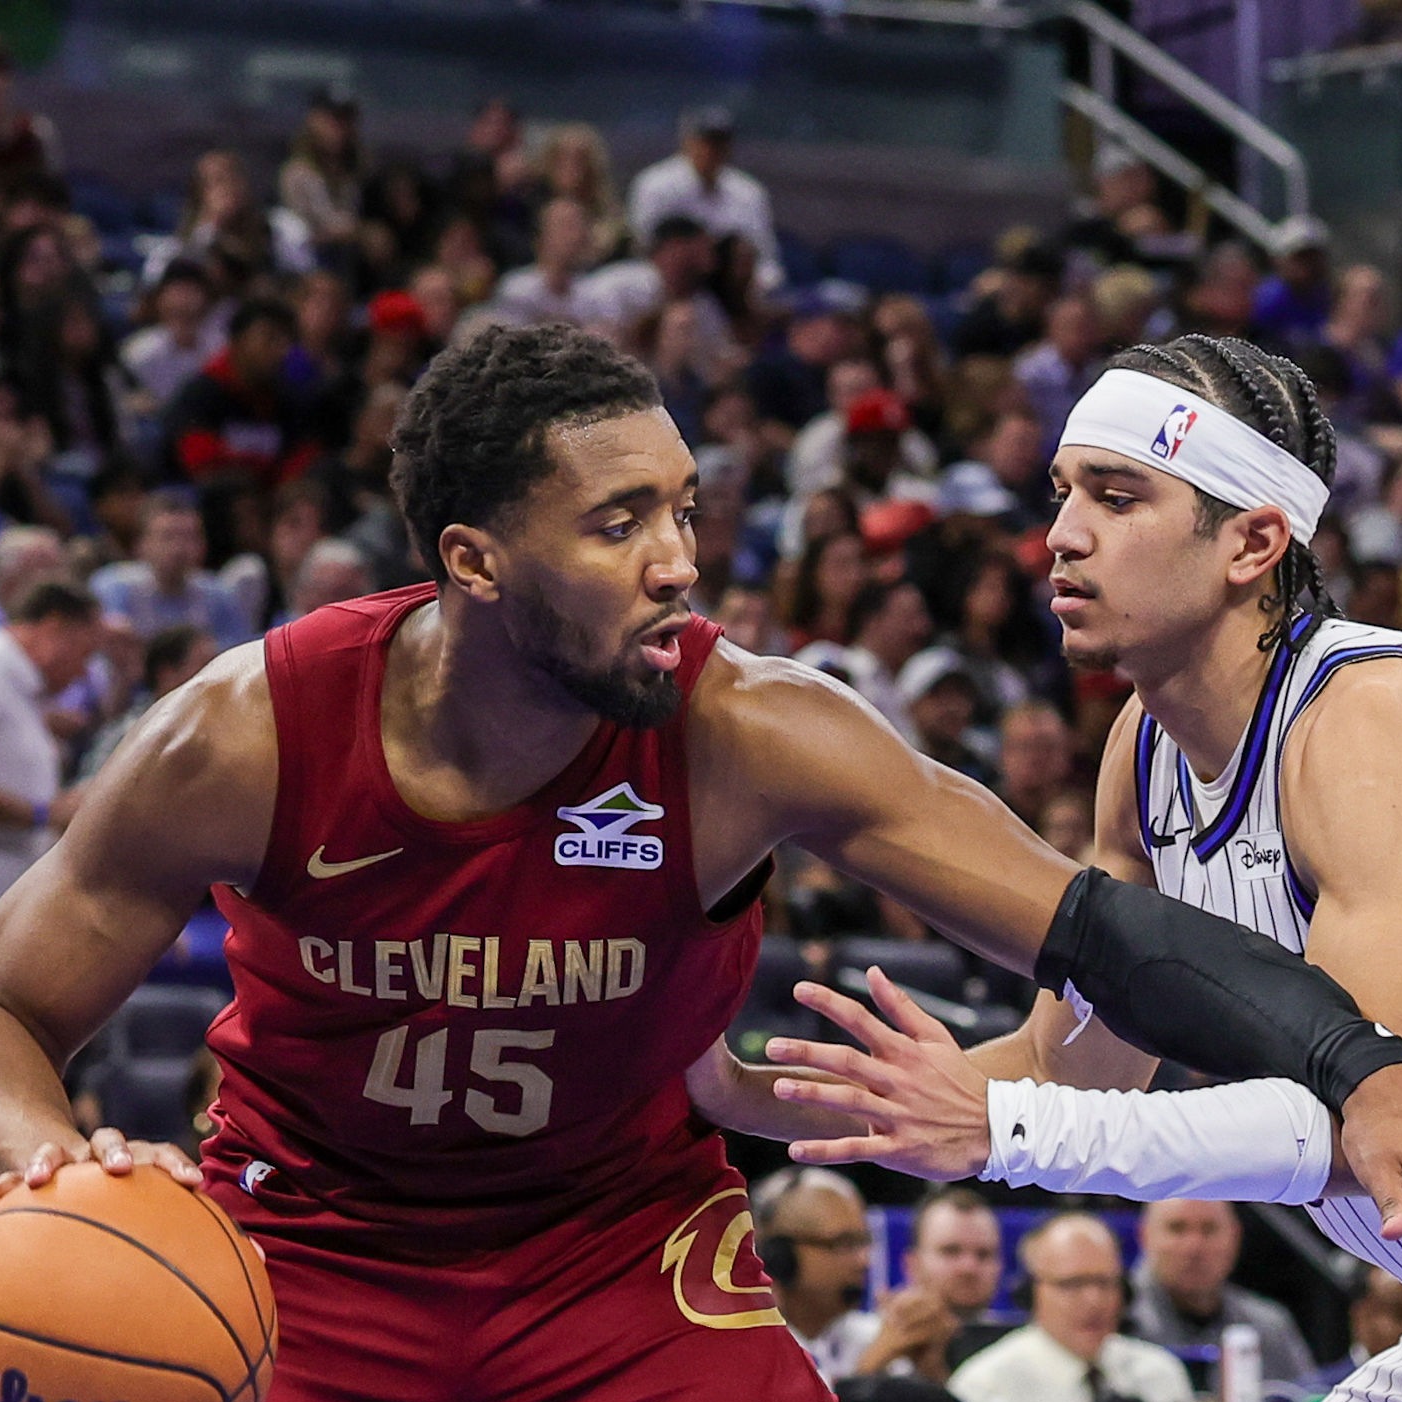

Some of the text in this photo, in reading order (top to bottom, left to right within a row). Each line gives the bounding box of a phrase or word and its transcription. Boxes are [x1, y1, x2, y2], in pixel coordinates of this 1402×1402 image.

[558, 839, 660, 863] CLIFFS
[1235, 840, 1281, 874] Disney
[298, 933, 646, 1009] CLEVELAND
[362, 1024, 556, 1138] 45
